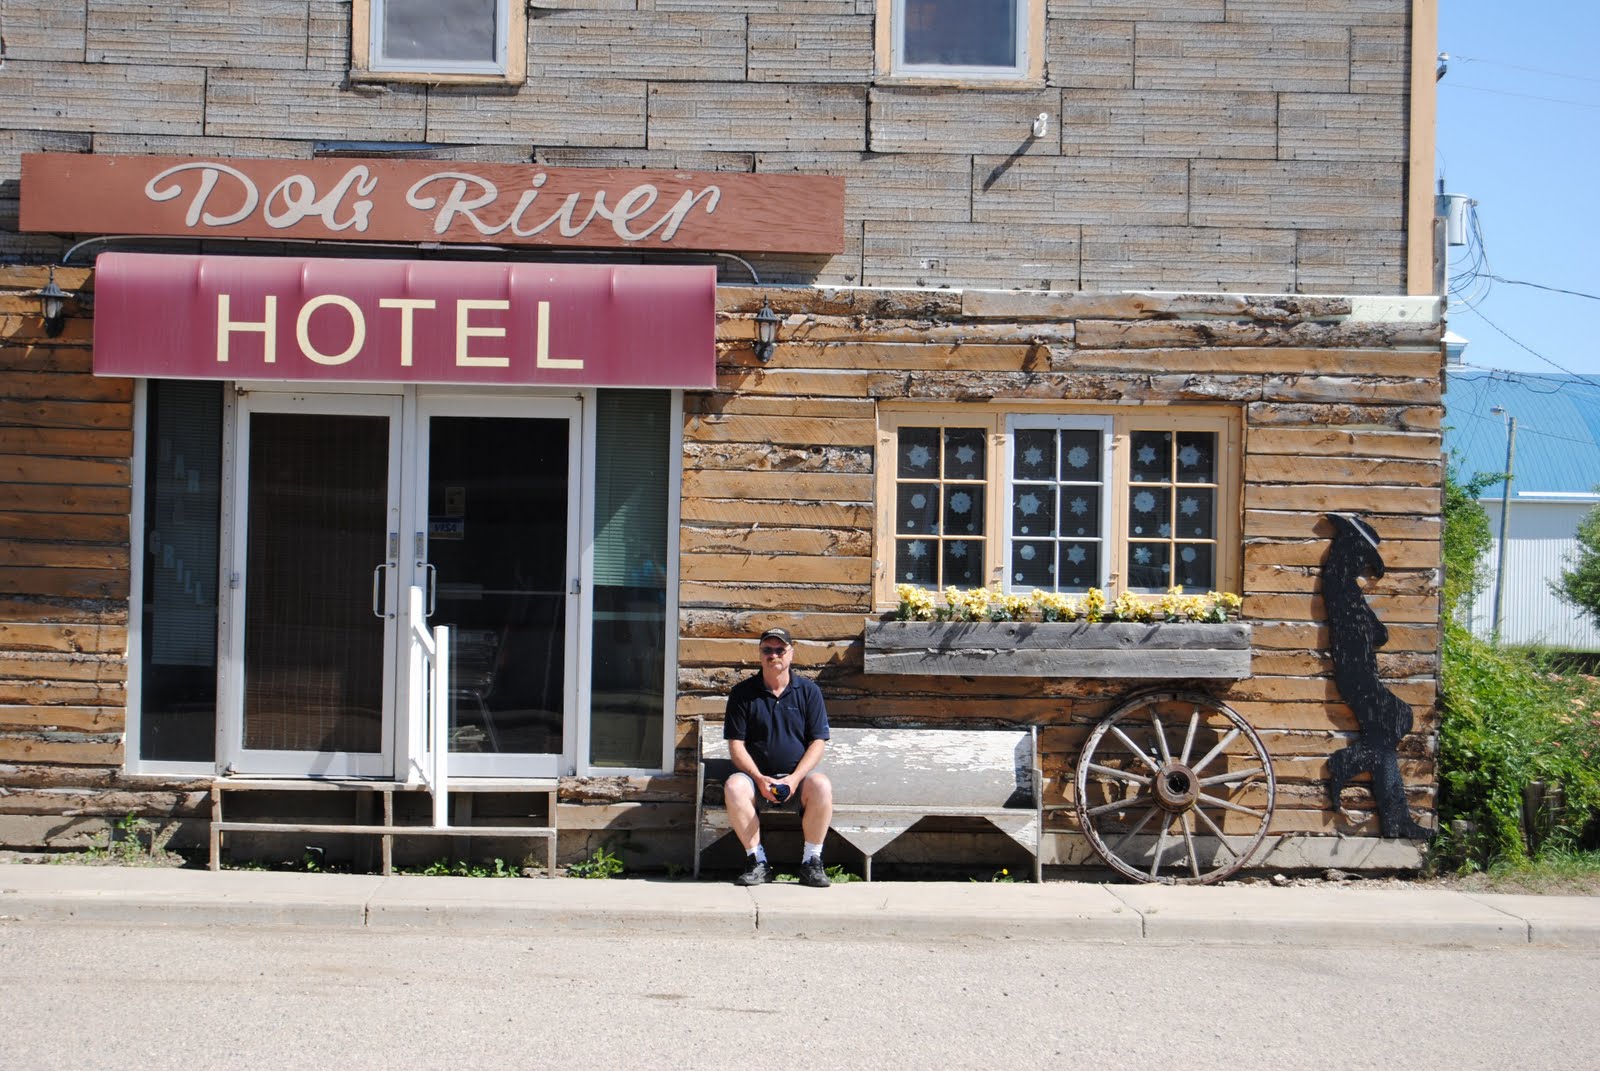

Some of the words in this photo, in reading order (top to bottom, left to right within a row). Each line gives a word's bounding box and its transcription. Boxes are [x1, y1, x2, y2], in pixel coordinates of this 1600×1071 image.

[405, 171, 721, 242] River
[216, 294, 584, 369] HOTEL
[433, 523, 457, 532] VISA
